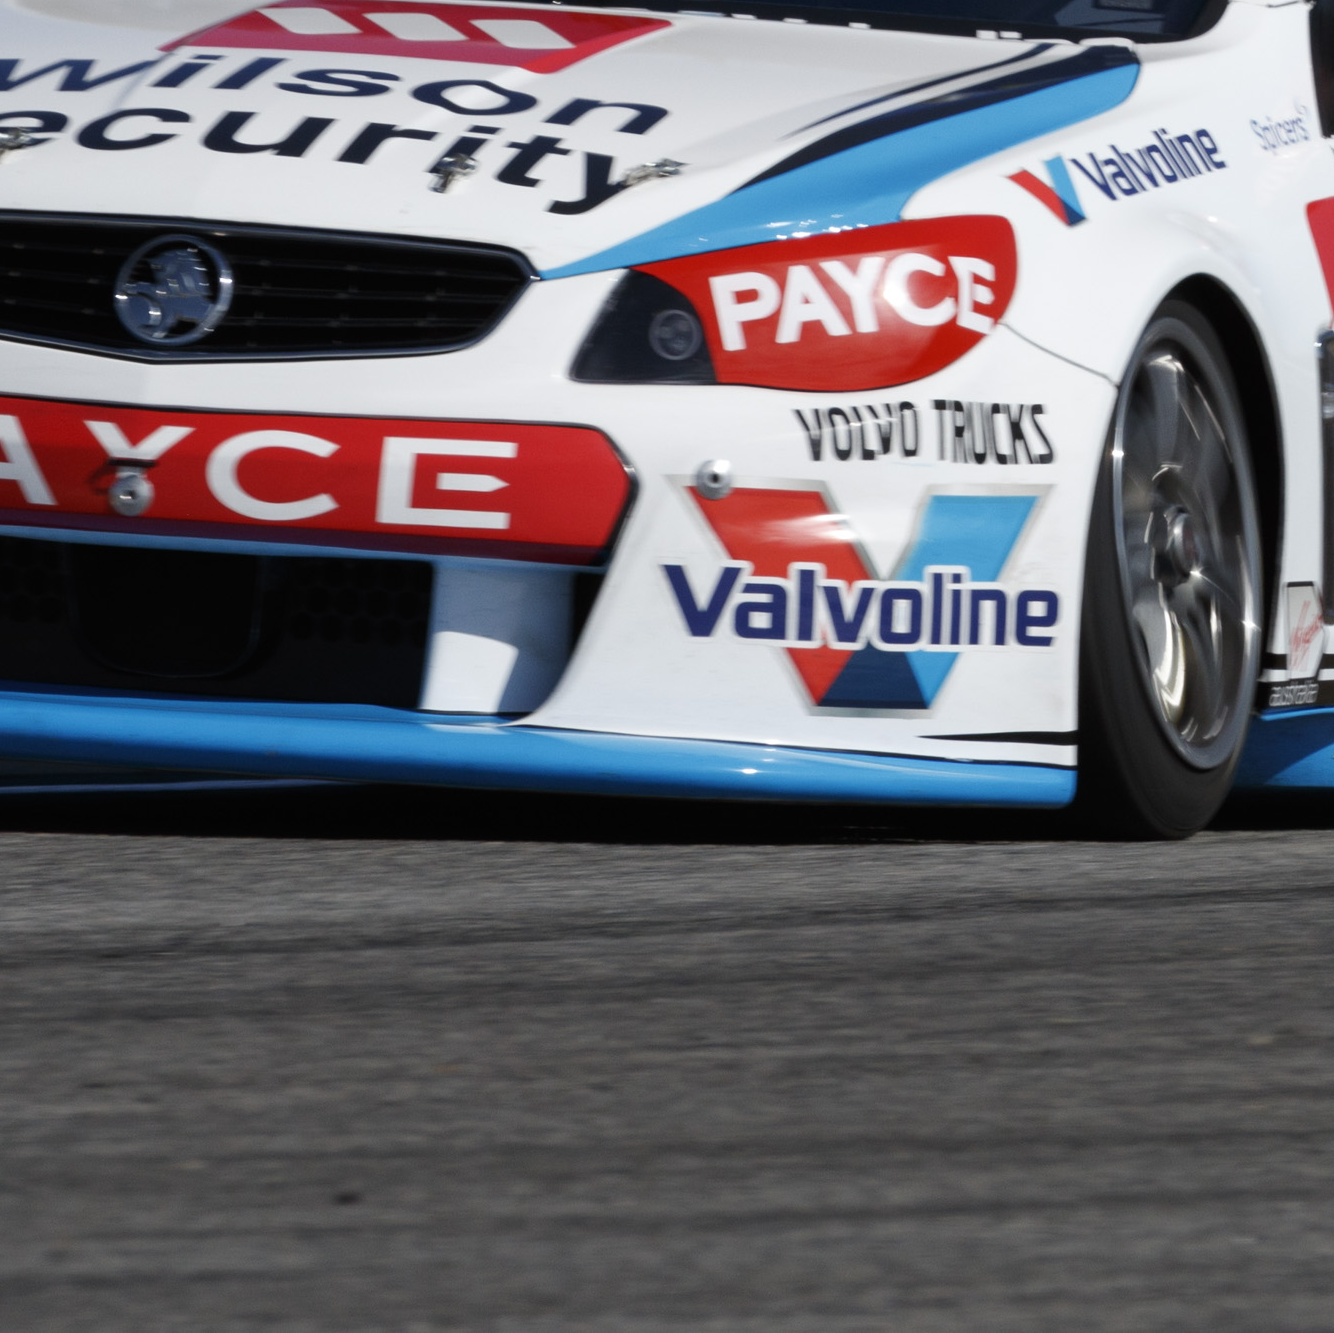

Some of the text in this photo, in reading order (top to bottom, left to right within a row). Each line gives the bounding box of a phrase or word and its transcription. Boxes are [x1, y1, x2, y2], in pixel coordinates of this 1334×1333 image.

[1072, 127, 1227, 200] Valvoline
[709, 252, 996, 352] PAYCE
[794, 399, 1055, 464] VOLVO TRUCKS
[661, 564, 1060, 648] Valvoline
